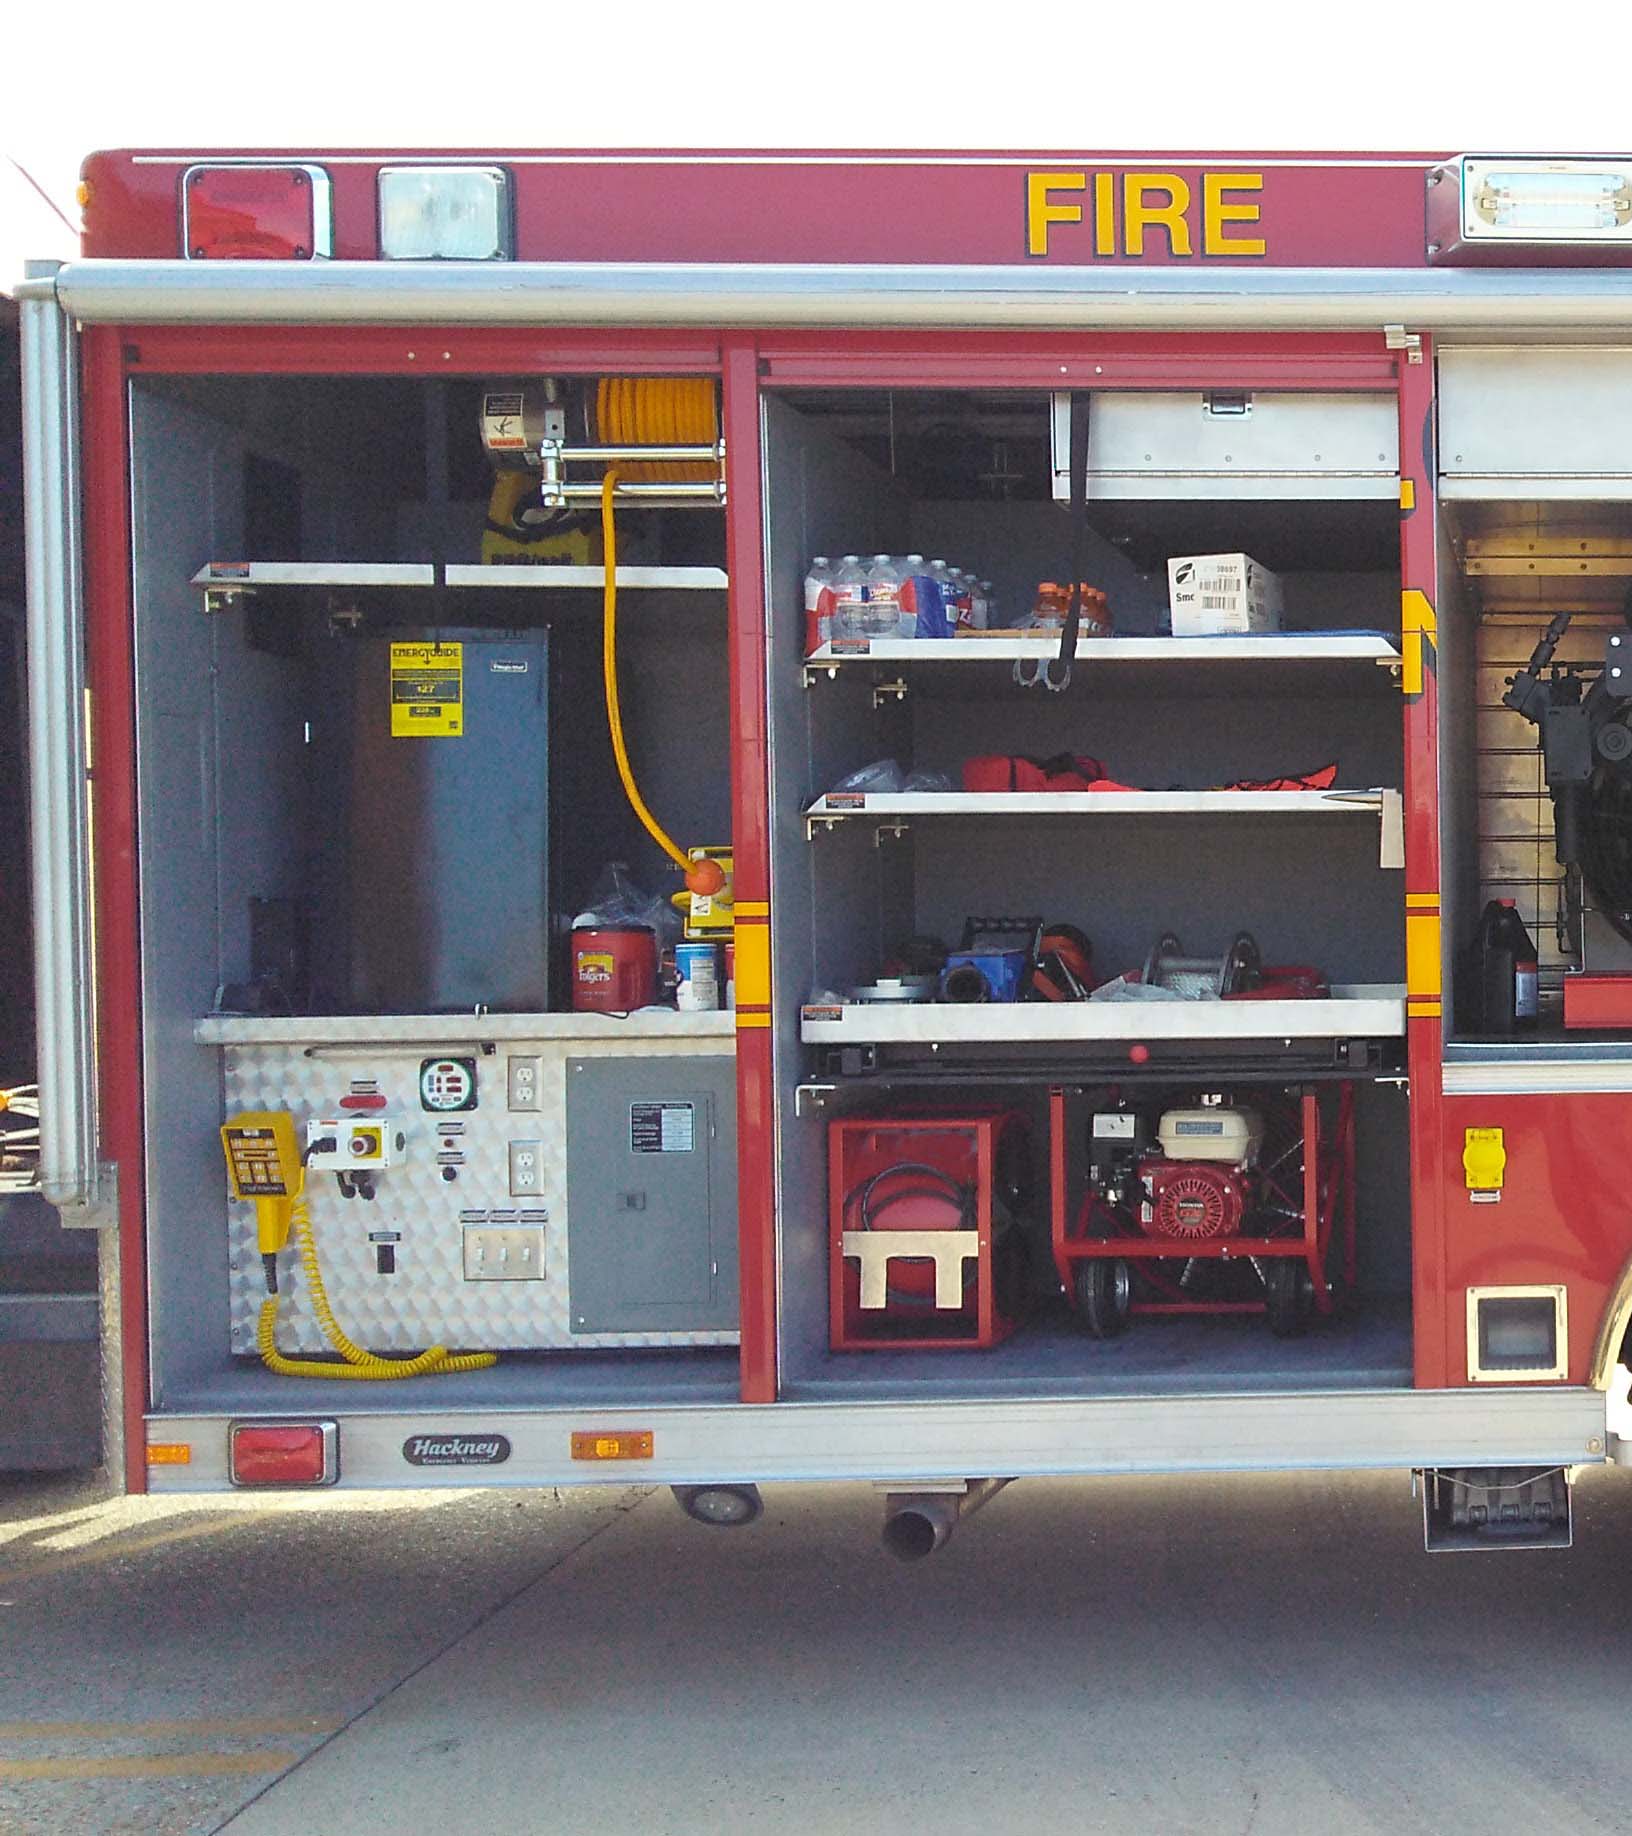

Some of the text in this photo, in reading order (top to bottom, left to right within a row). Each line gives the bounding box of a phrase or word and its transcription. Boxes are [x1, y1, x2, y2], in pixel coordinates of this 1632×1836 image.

[1026, 172, 1266, 257] FIRE
[578, 969, 611, 984] Folgers
[413, 1438, 500, 1458] Hackney
